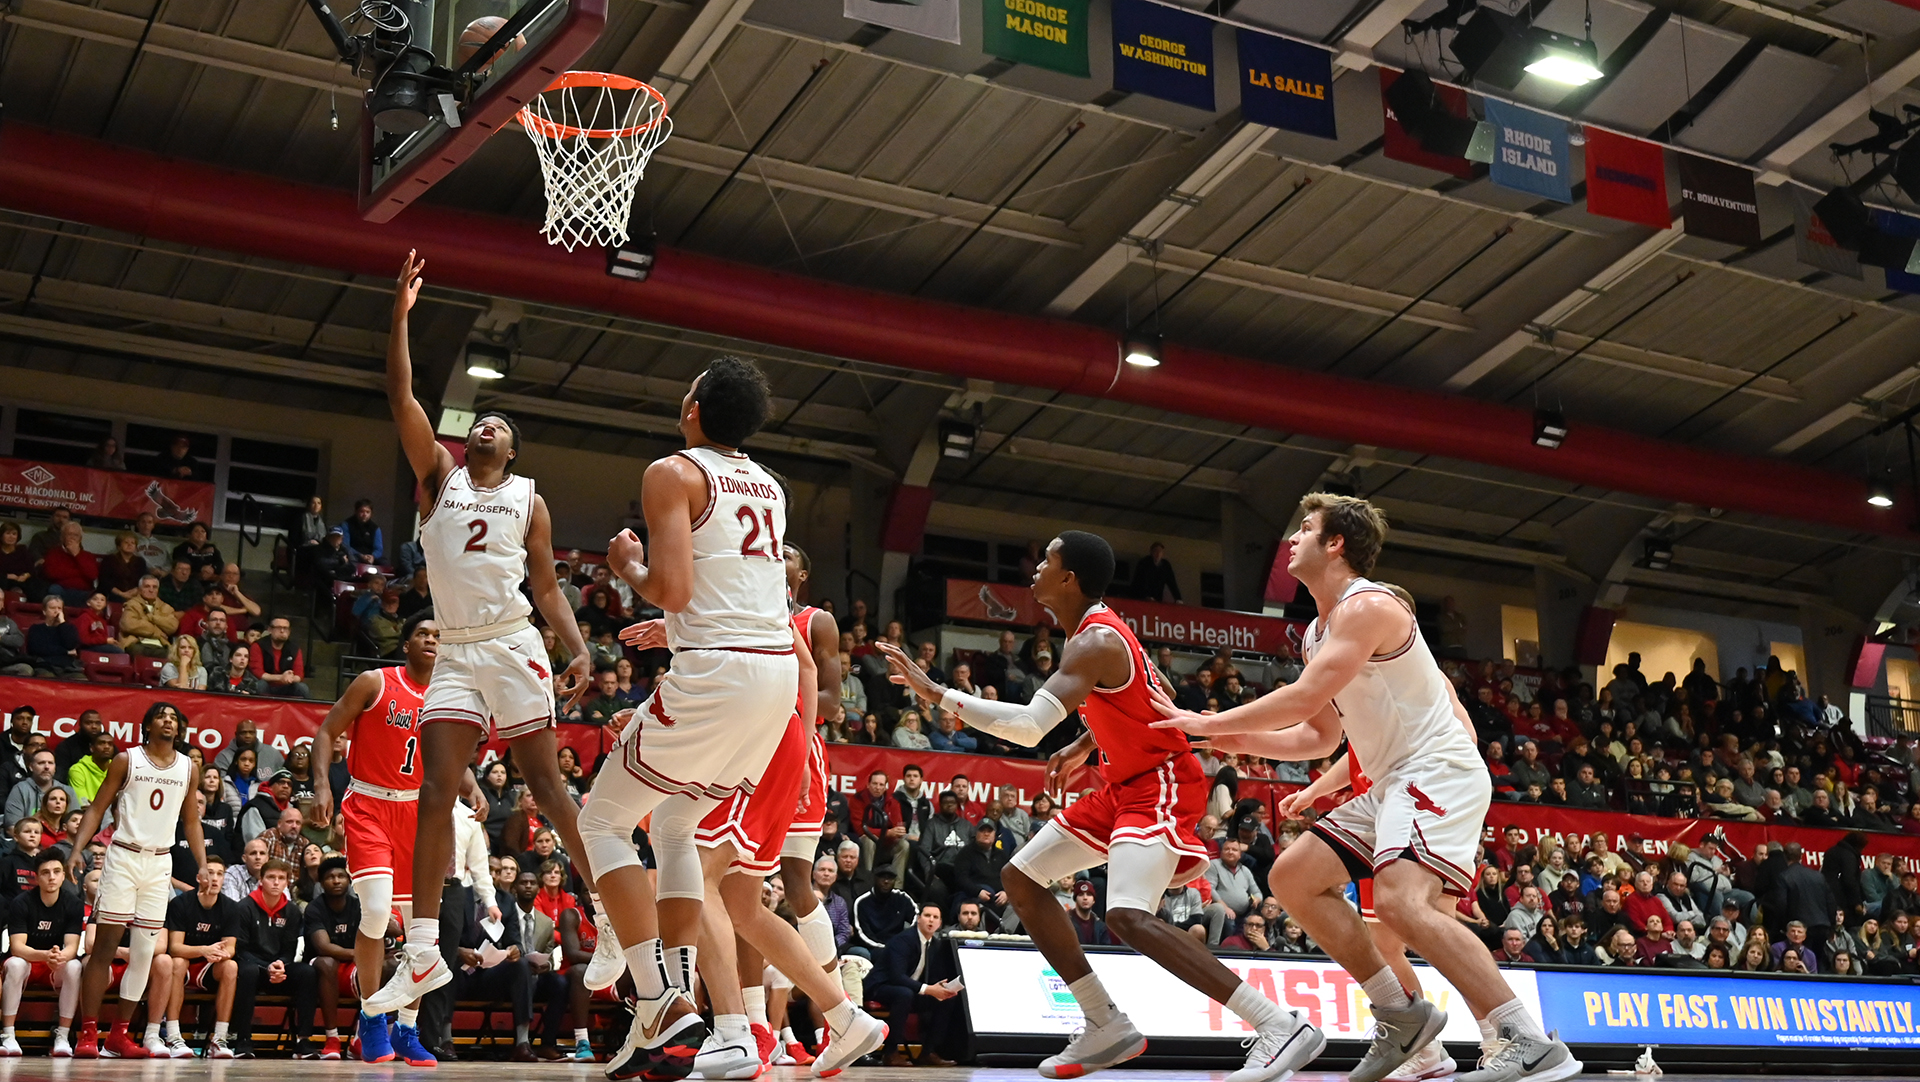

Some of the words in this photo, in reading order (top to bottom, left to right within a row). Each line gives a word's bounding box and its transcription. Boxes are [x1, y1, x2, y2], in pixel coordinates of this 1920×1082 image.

[1004, 0, 1068, 24] GEORGE
[1006, 14, 1067, 44] MASON
[1119, 43, 1206, 76] WASHINGTON
[1139, 34, 1186, 56] GEORGE
[1249, 69, 1271, 88] LA
[1274, 75, 1324, 100] SALLE
[1503, 127, 1552, 155] RHODE
[1502, 146, 1557, 176] ISLAND
[717, 475, 778, 501] EDWARDS
[473, 504, 521, 519] JOSEPH'S
[463, 518, 488, 553] 2
[734, 504, 783, 563] 21
[1142, 612, 1185, 646] Line
[386, 700, 413, 731] Saint
[399, 736, 417, 775] 1
[135, 775, 154, 784] SAINT
[150, 788, 164, 811] 0
[1584, 991, 1649, 1027] PLAY
[1658, 993, 1728, 1029] FAST.
[1730, 995, 1788, 1030] WIN
[1790, 997, 1920, 1033] INSTANTLY.
